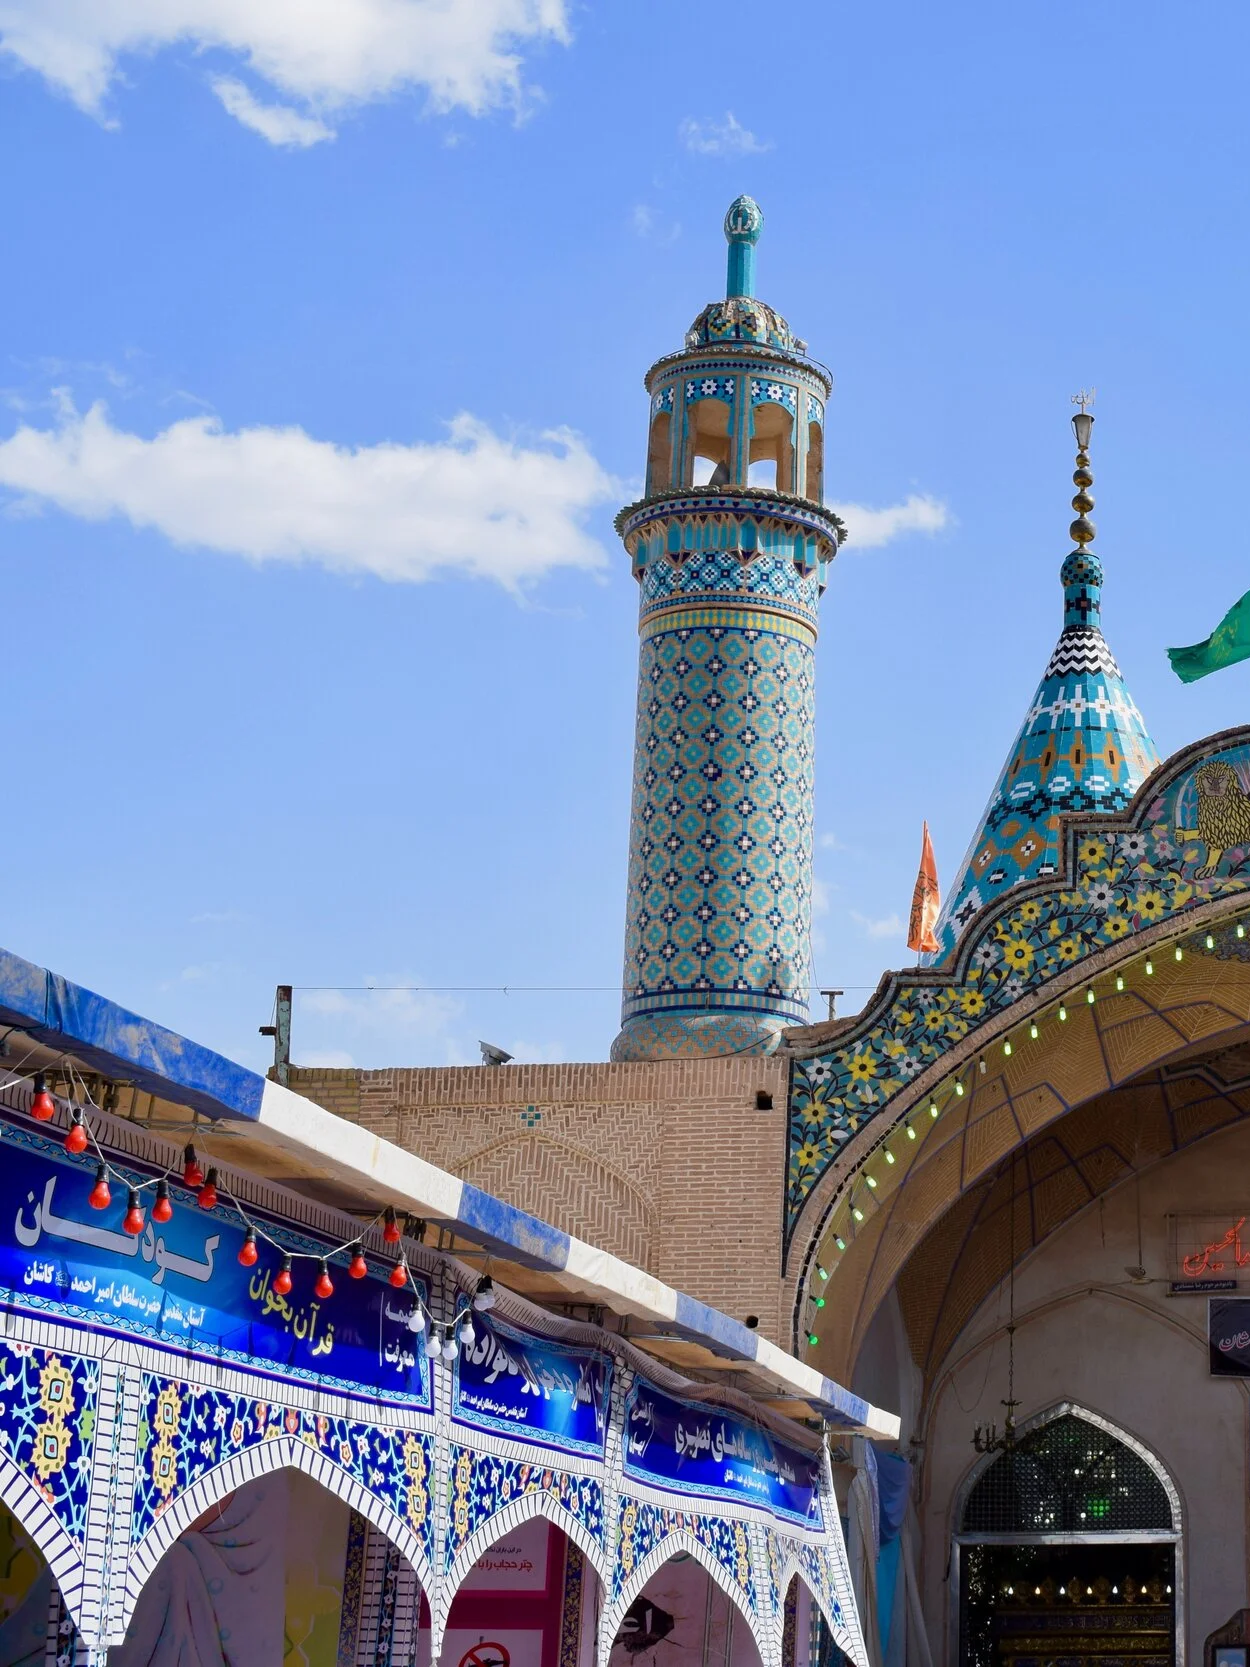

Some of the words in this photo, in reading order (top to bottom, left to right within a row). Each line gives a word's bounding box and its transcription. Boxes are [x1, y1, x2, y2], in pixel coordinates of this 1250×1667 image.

[24, 1259, 55, 1286] کاشان
[71, 1275, 96, 1295] احمد
[94, 1281, 114, 1303] امیر
[113, 1283, 141, 1308] سلطان
[486, 1560, 494, 1571] را
[494, 1560, 517, 1571] حجاب
[518, 1560, 533, 1572] چتر
